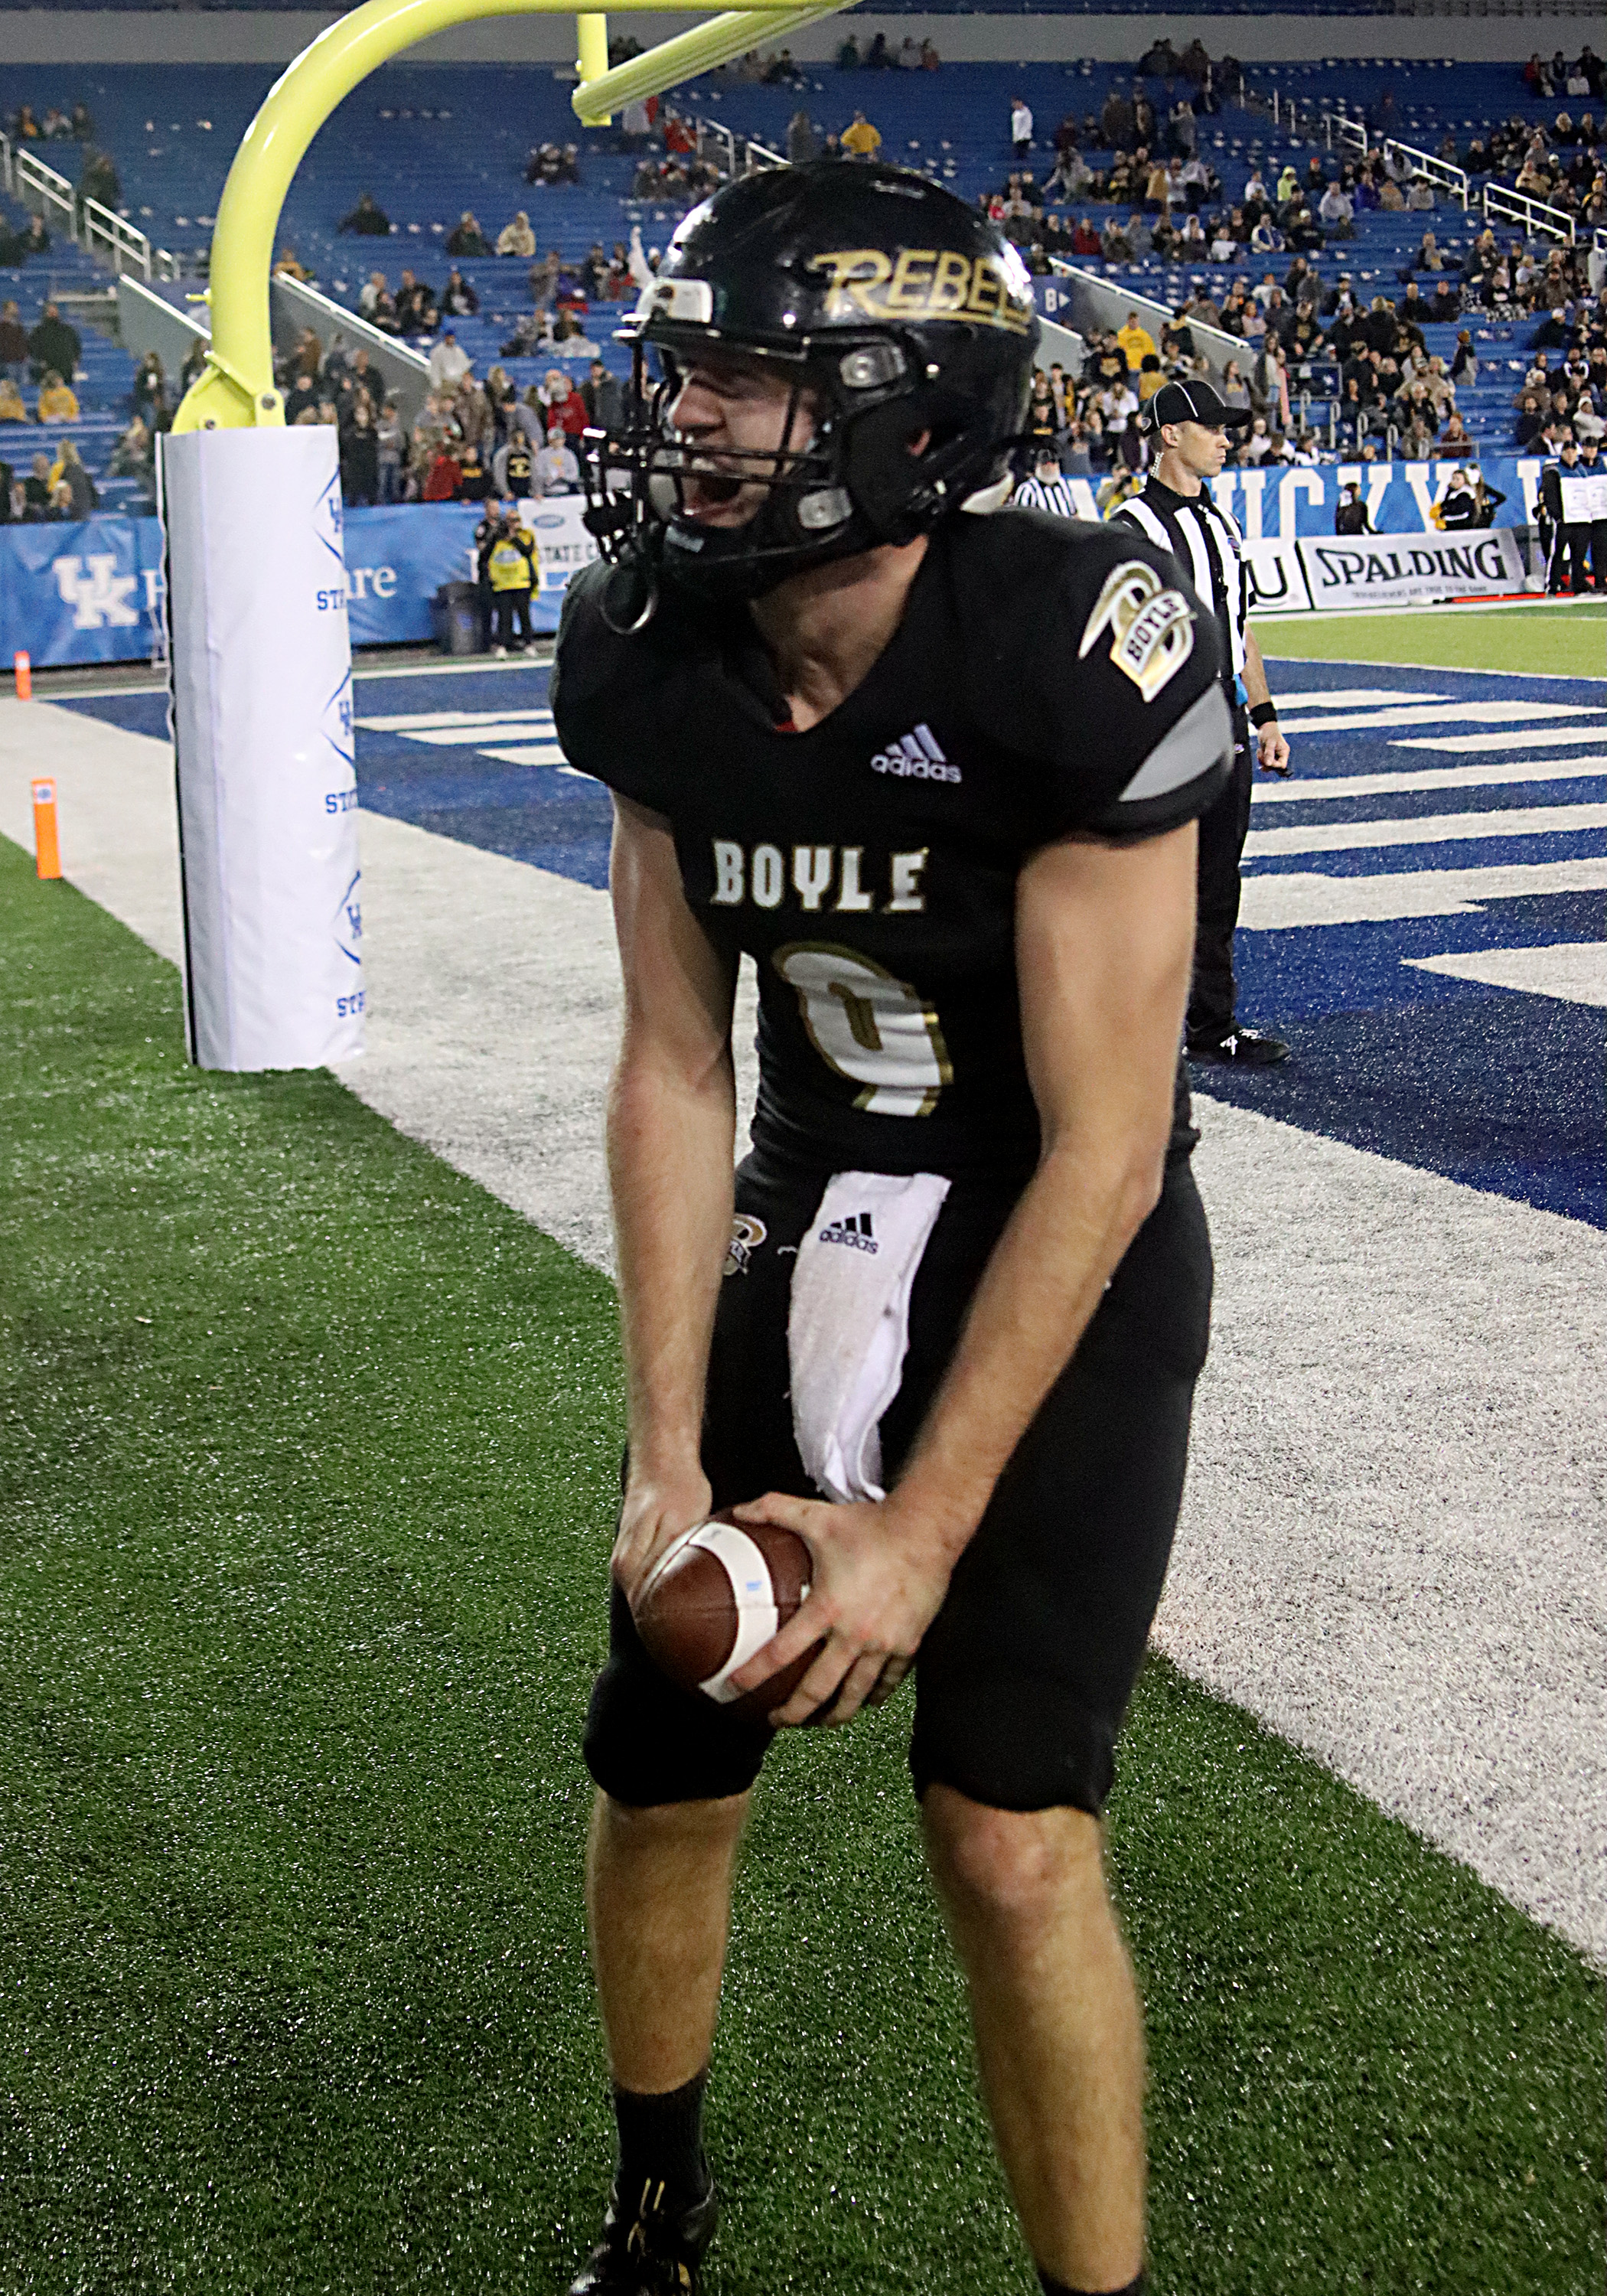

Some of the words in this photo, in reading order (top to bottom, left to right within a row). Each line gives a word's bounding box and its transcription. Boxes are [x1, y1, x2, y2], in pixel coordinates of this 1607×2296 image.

[1315, 539, 1510, 588] SPALDING
[1126, 598, 1180, 662] BOYLE
[870, 753, 962, 783] adidas
[711, 840, 930, 913] BOYLE
[820, 1228, 878, 1254] adidas
